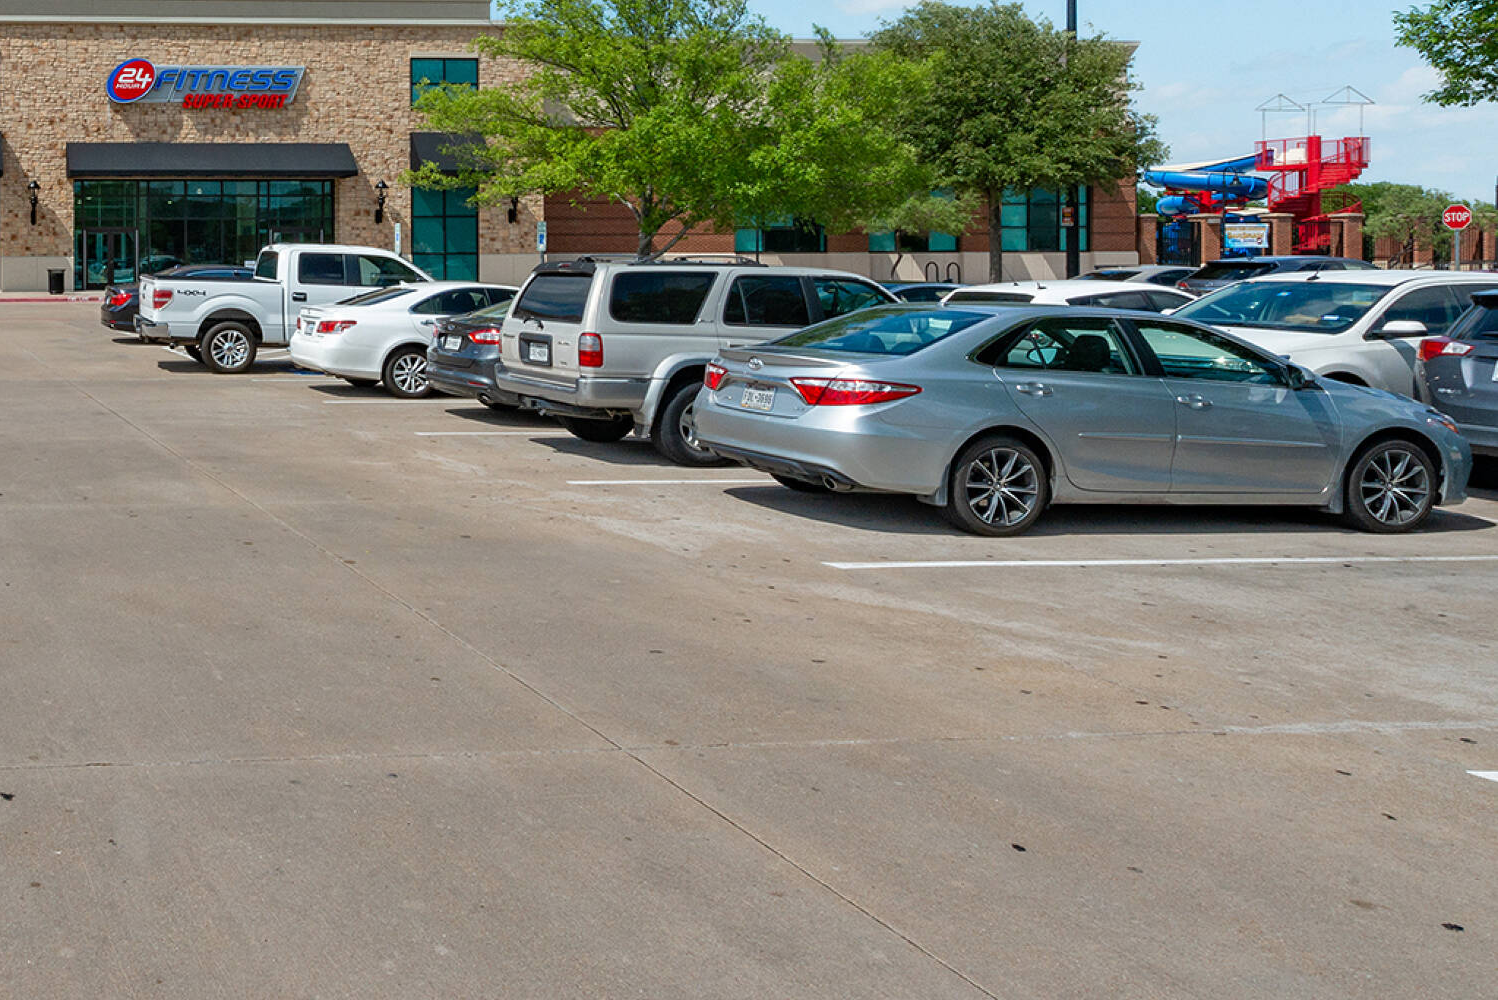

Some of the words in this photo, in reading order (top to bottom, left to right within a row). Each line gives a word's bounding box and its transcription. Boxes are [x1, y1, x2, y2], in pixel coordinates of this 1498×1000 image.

[117, 67, 152, 89] 24
[153, 69, 298, 91] FITNESS
[1444, 211, 1470, 223] STOP
